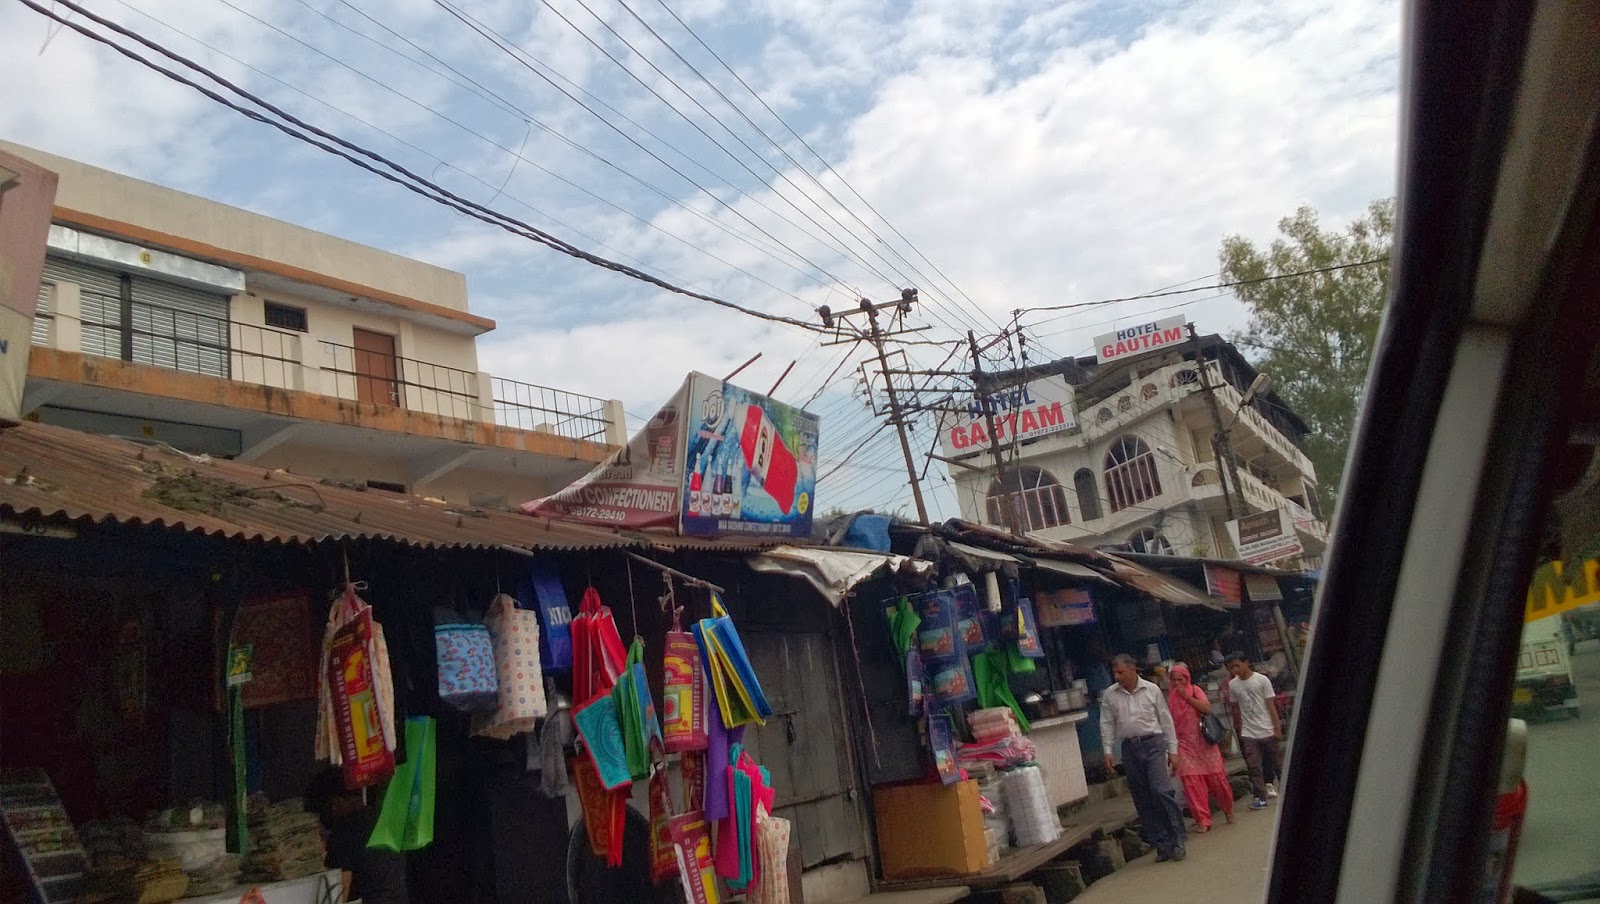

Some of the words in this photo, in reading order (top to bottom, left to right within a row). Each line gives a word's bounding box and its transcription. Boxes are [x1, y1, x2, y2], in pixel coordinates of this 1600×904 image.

[1102, 327, 1182, 359] GAUTAM
[1117, 322, 1161, 341] HOTEL
[951, 401, 1065, 449] GAUTAM
[586, 487, 676, 513] CONFECTIONERY
